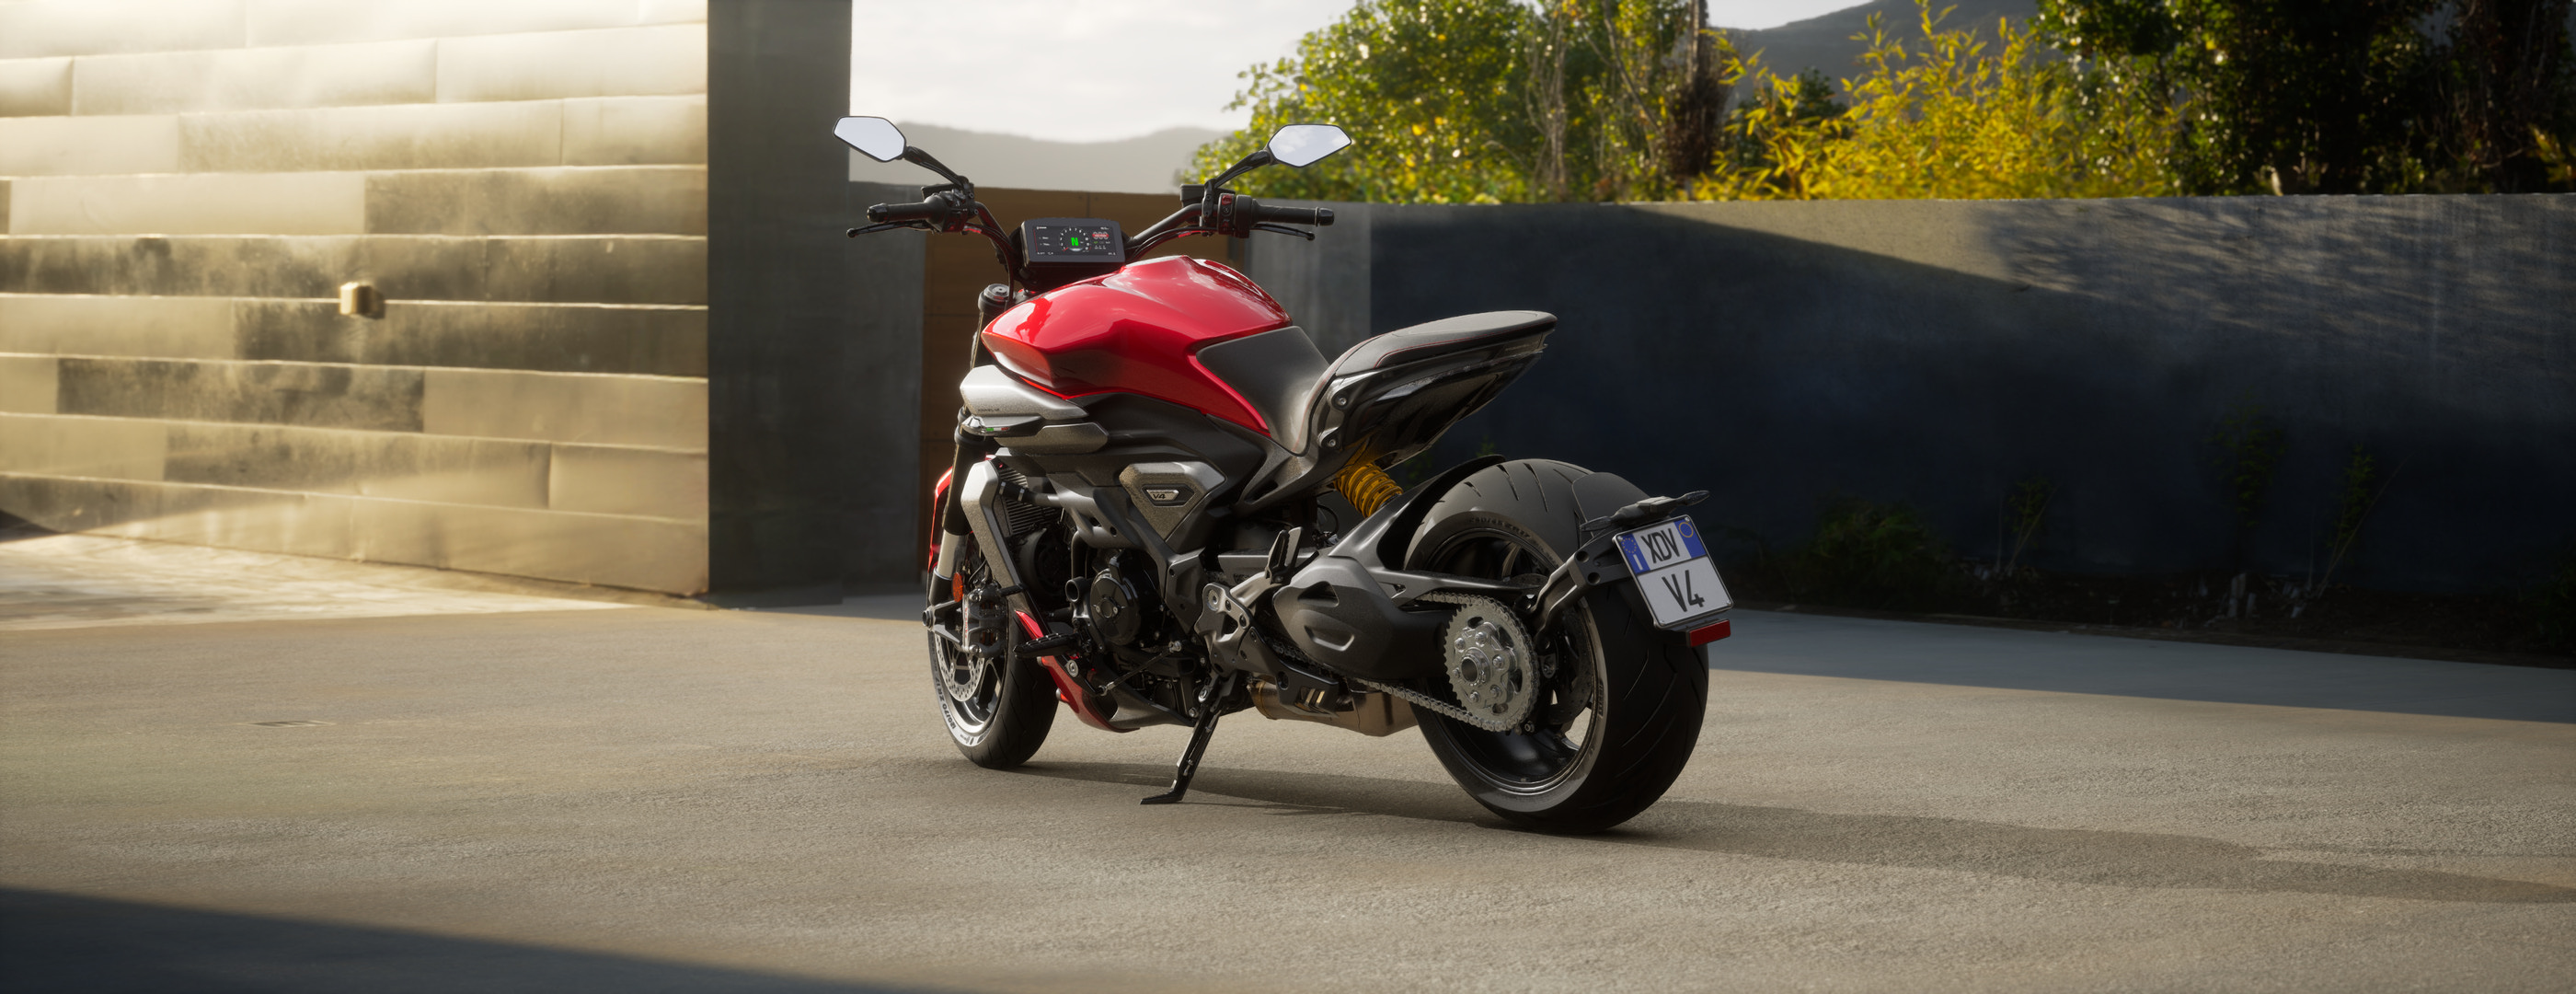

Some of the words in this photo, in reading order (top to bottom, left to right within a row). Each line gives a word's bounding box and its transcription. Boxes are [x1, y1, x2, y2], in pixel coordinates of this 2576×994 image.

[1071, 237, 1079, 247] N
[1640, 528, 1680, 563] XDV
[1662, 570, 1705, 612] V4
